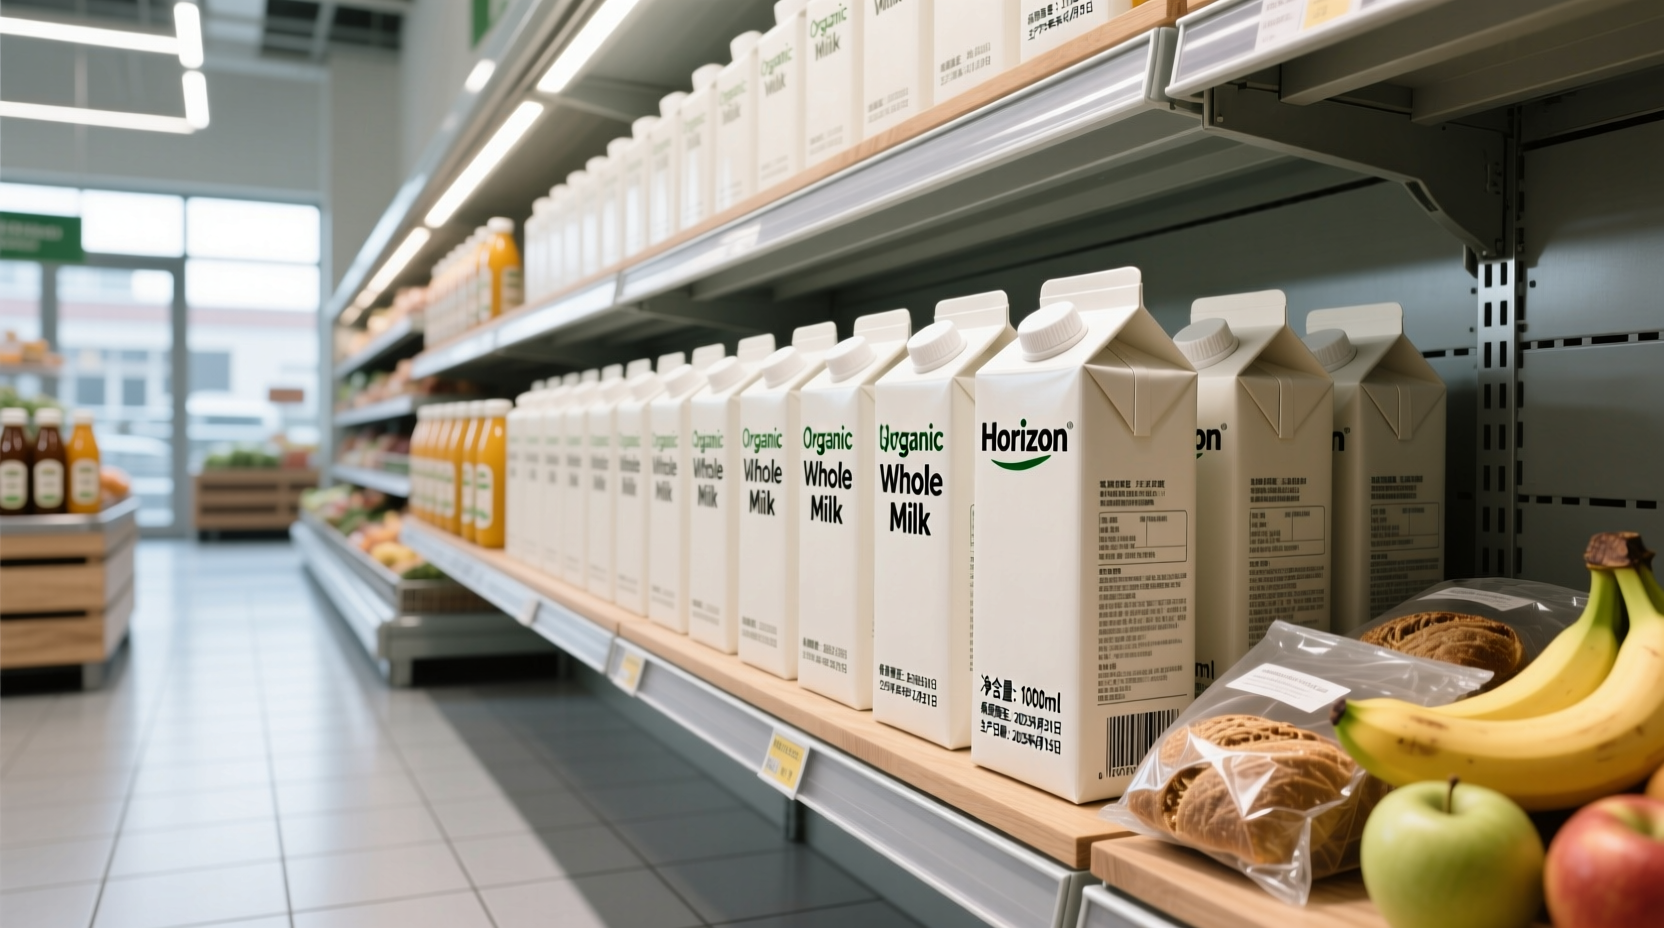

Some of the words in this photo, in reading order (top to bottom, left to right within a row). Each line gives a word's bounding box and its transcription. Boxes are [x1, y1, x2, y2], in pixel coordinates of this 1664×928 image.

[742, 427, 783, 454] Organic
[803, 424, 853, 456] Organic
[981, 418, 1068, 452] Horizon
[743, 458, 783, 484] Whole
[803, 460, 853, 490] Whole
[879, 463, 943, 497] Whole
[749, 489, 776, 517] Milk
[810, 494, 843, 525] Milk
[889, 501, 932, 537] Milk
[1021, 685, 1061, 714] 1000ml
